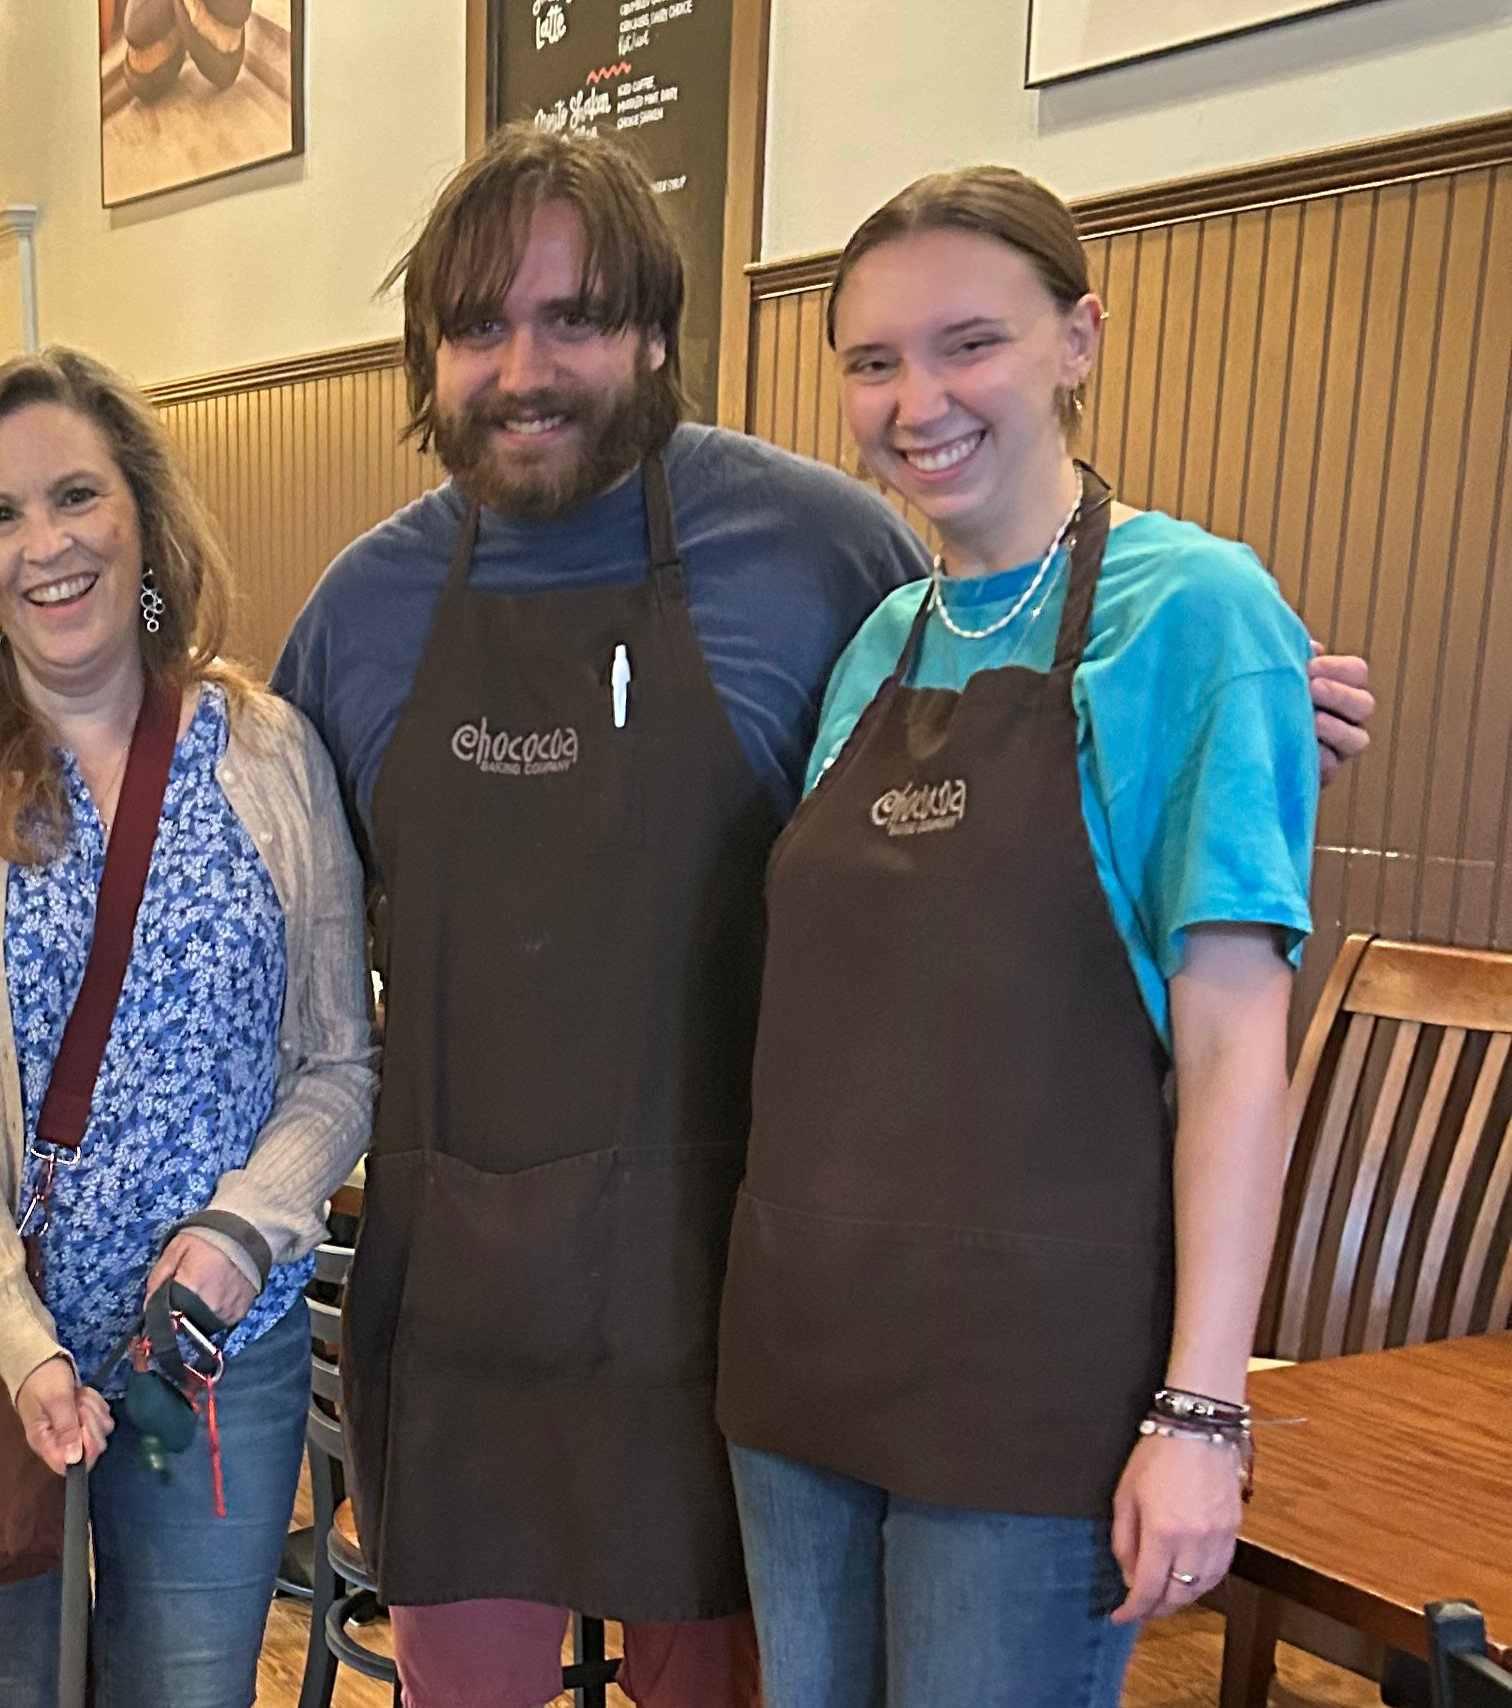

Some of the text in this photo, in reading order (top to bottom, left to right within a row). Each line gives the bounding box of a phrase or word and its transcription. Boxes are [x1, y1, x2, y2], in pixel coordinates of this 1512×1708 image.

[668, 0, 693, 19] CHOICE
[535, 4, 567, 51] Latte
[617, 82, 632, 97] ICED
[569, 87, 612, 130] Shaken
[451, 716, 578, 765] Chococoa
[480, 759, 571, 775] BAKING COMPANY
